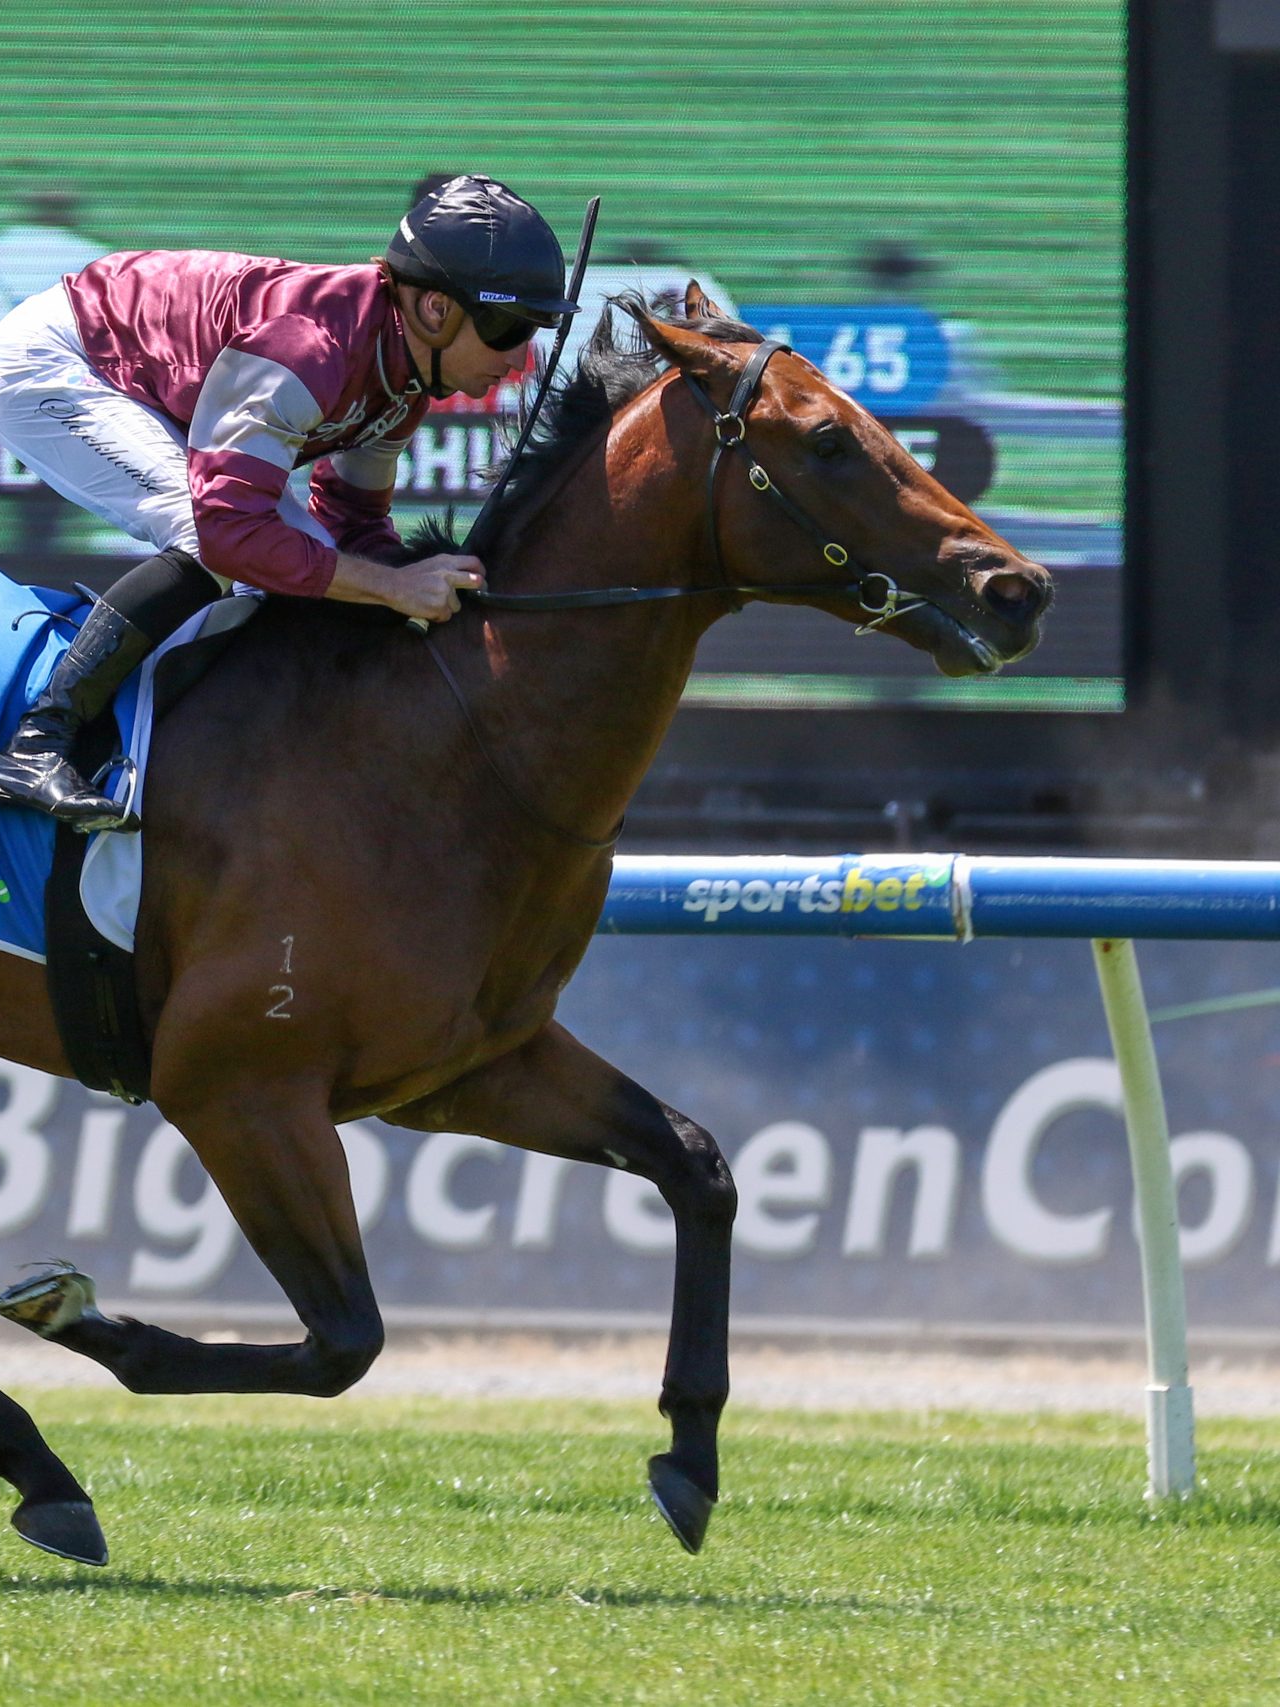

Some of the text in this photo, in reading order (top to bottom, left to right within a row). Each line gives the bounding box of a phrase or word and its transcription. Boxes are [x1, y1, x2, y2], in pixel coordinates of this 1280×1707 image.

[765, 322, 911, 393] 65
[683, 866, 927, 922] sportsbet
[281, 935, 294, 974] 1
[265, 984, 294, 1018] 2
